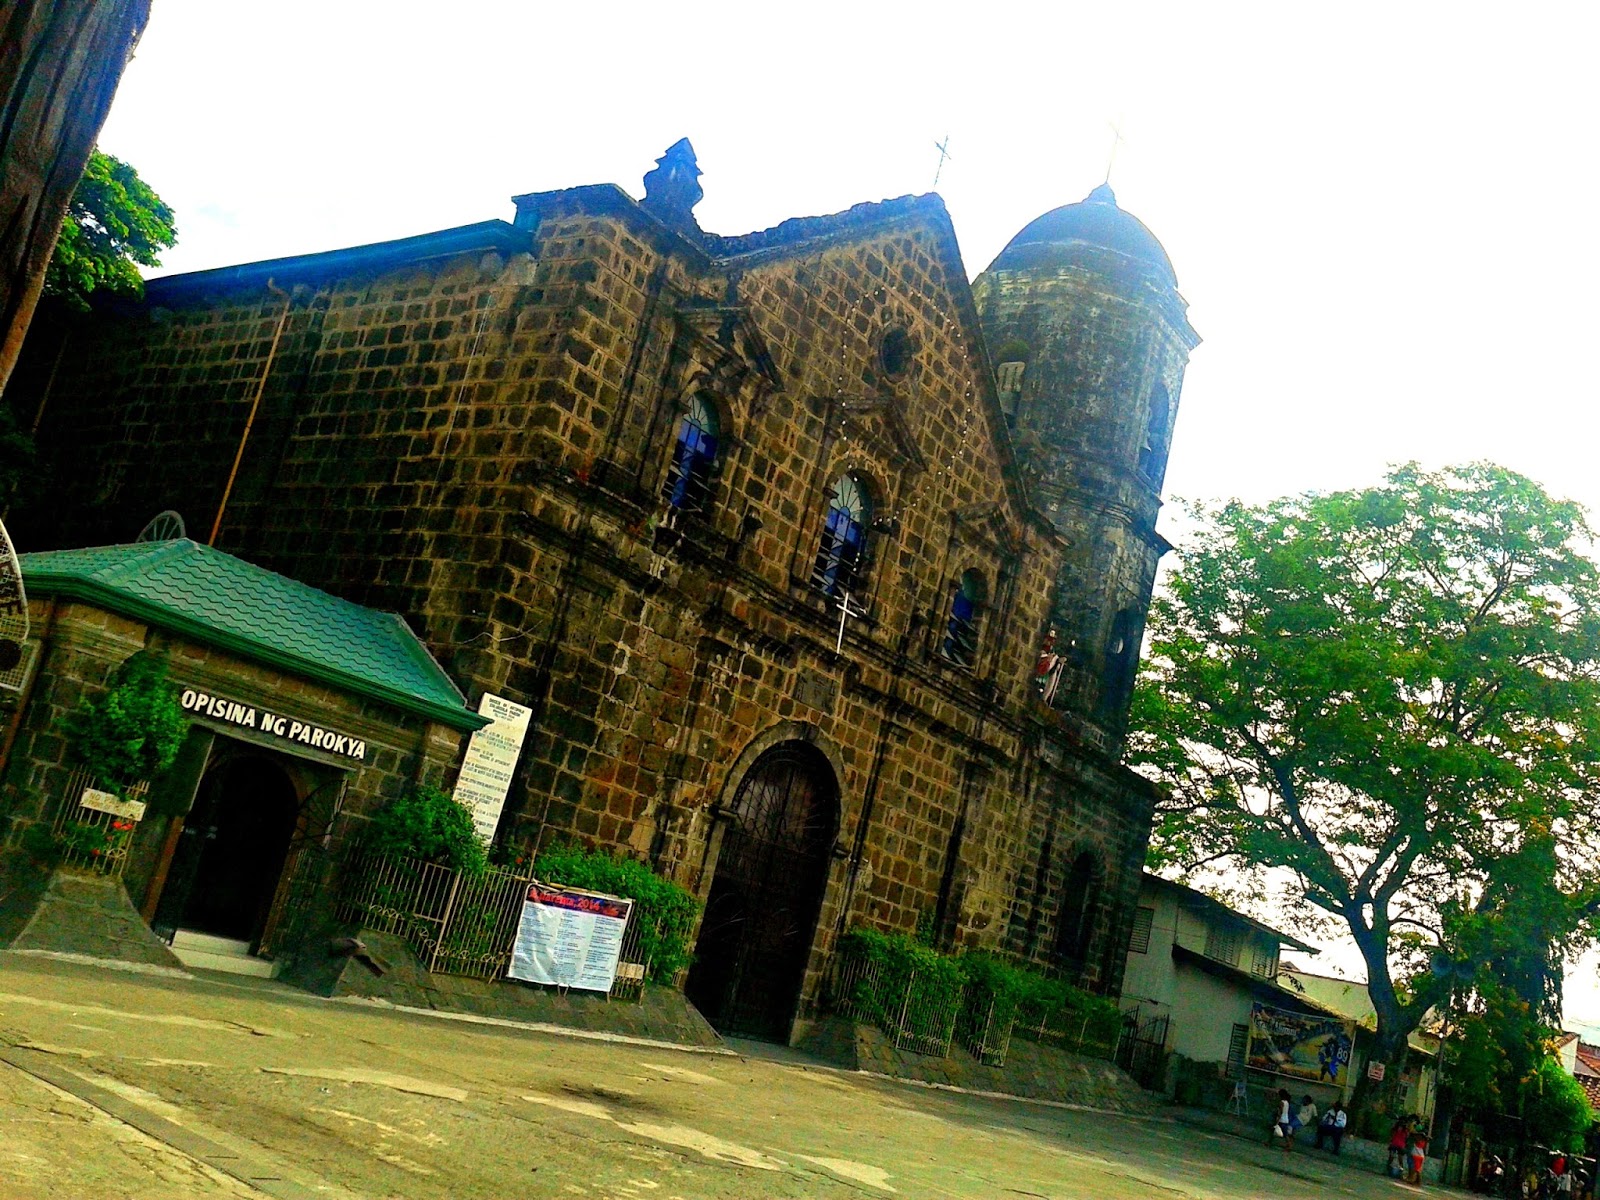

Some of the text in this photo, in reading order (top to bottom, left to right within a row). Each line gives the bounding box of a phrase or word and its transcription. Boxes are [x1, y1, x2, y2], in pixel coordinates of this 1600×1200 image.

[181, 690, 366, 760] OPISINA NG PAROKYA
